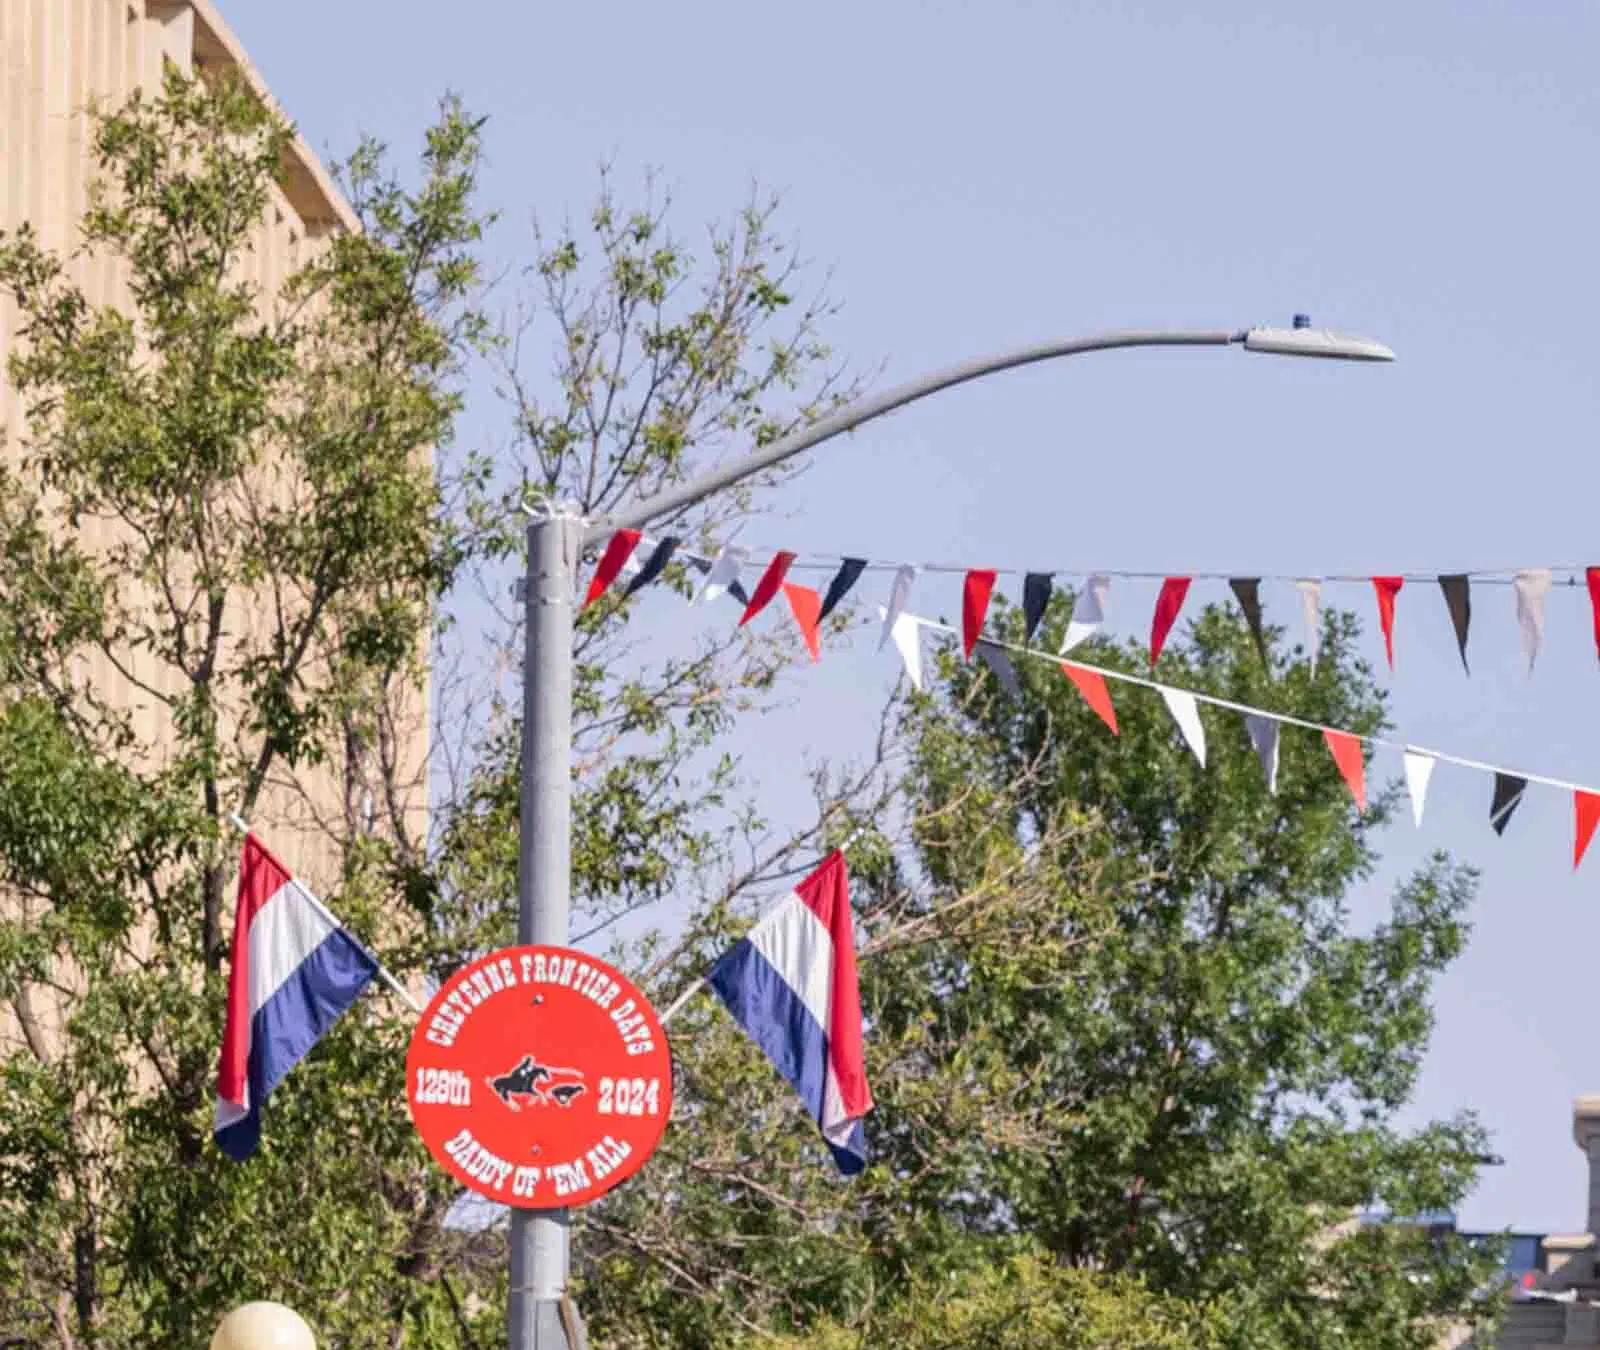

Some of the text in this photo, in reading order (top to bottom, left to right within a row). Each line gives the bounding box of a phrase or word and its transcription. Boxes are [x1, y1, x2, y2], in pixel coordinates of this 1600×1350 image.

[426, 953, 655, 1056] CHEYENNE FRONTIER DAYS
[415, 1066, 471, 1106] 128th
[597, 1077, 660, 1115] 2024
[443, 1129, 512, 1191] DADDY
[511, 1166, 541, 1198] OF
[586, 1135, 632, 1179] ALL
